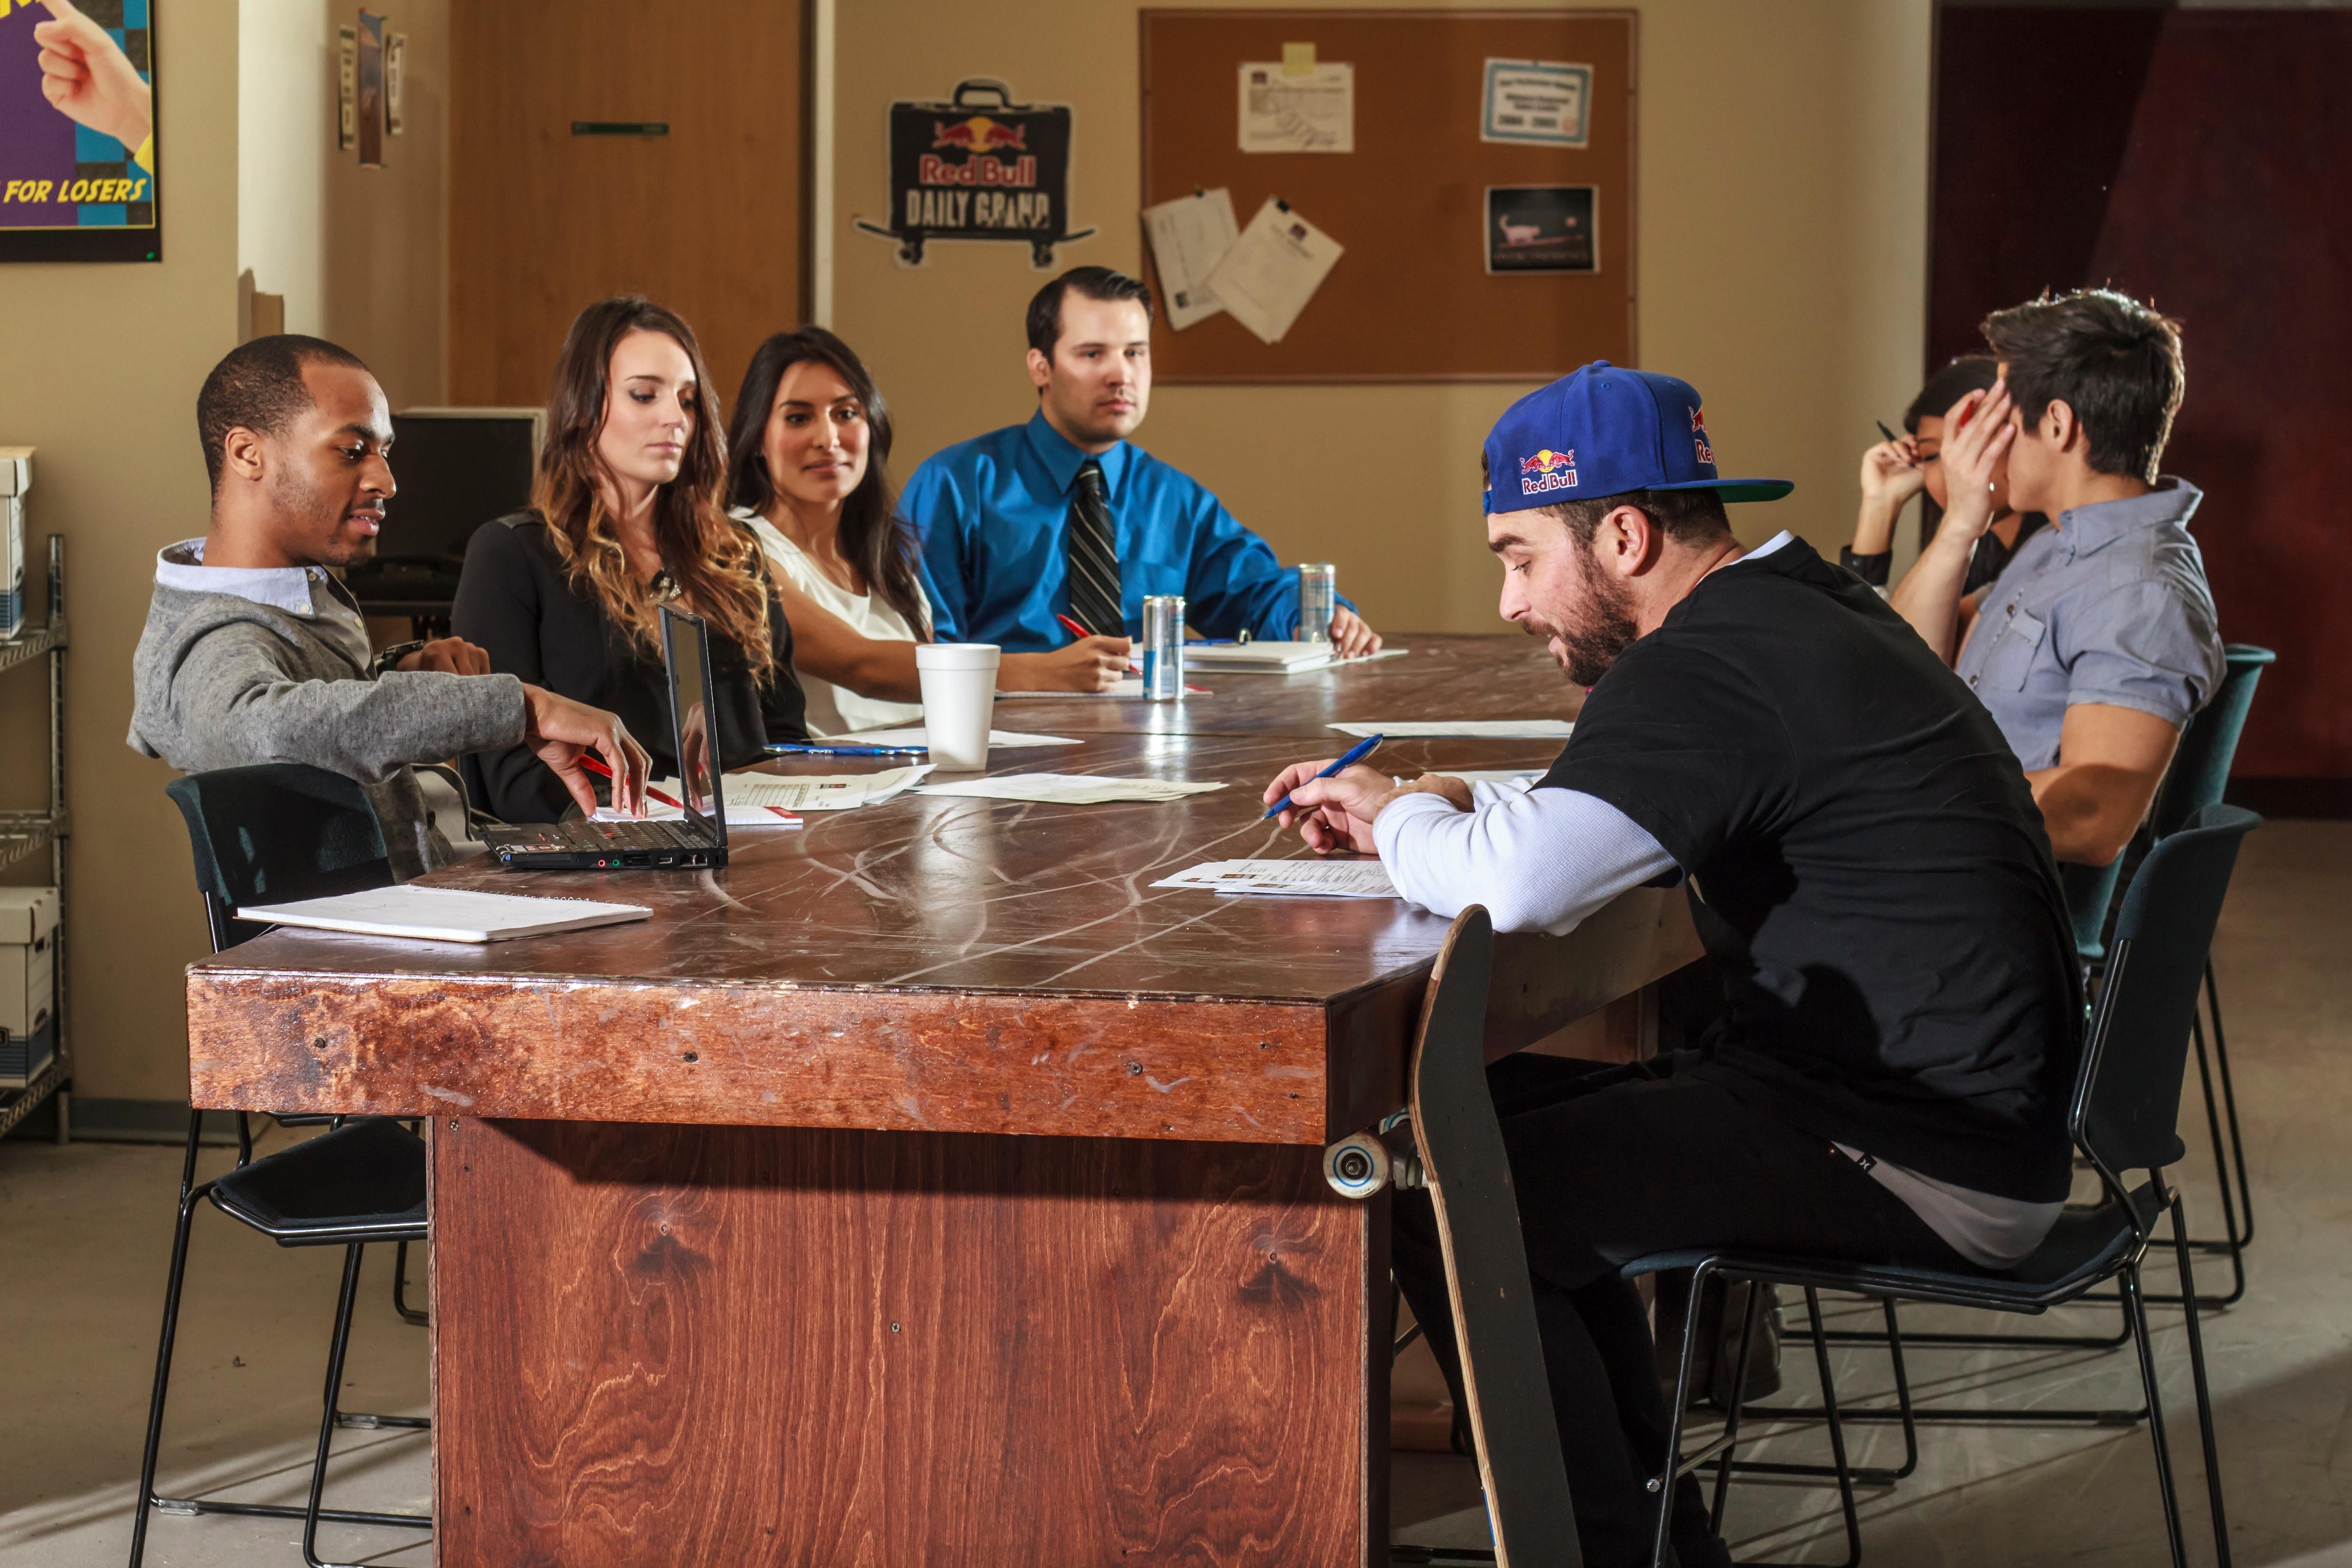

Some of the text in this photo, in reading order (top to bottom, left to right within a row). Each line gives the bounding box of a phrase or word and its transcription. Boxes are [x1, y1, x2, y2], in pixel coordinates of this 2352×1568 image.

[919, 154, 1037, 187] Red Bull
[3, 178, 147, 203] FOR LOSERS
[906, 190, 970, 228] DAILY
[1522, 469, 1578, 494] Red Bull
